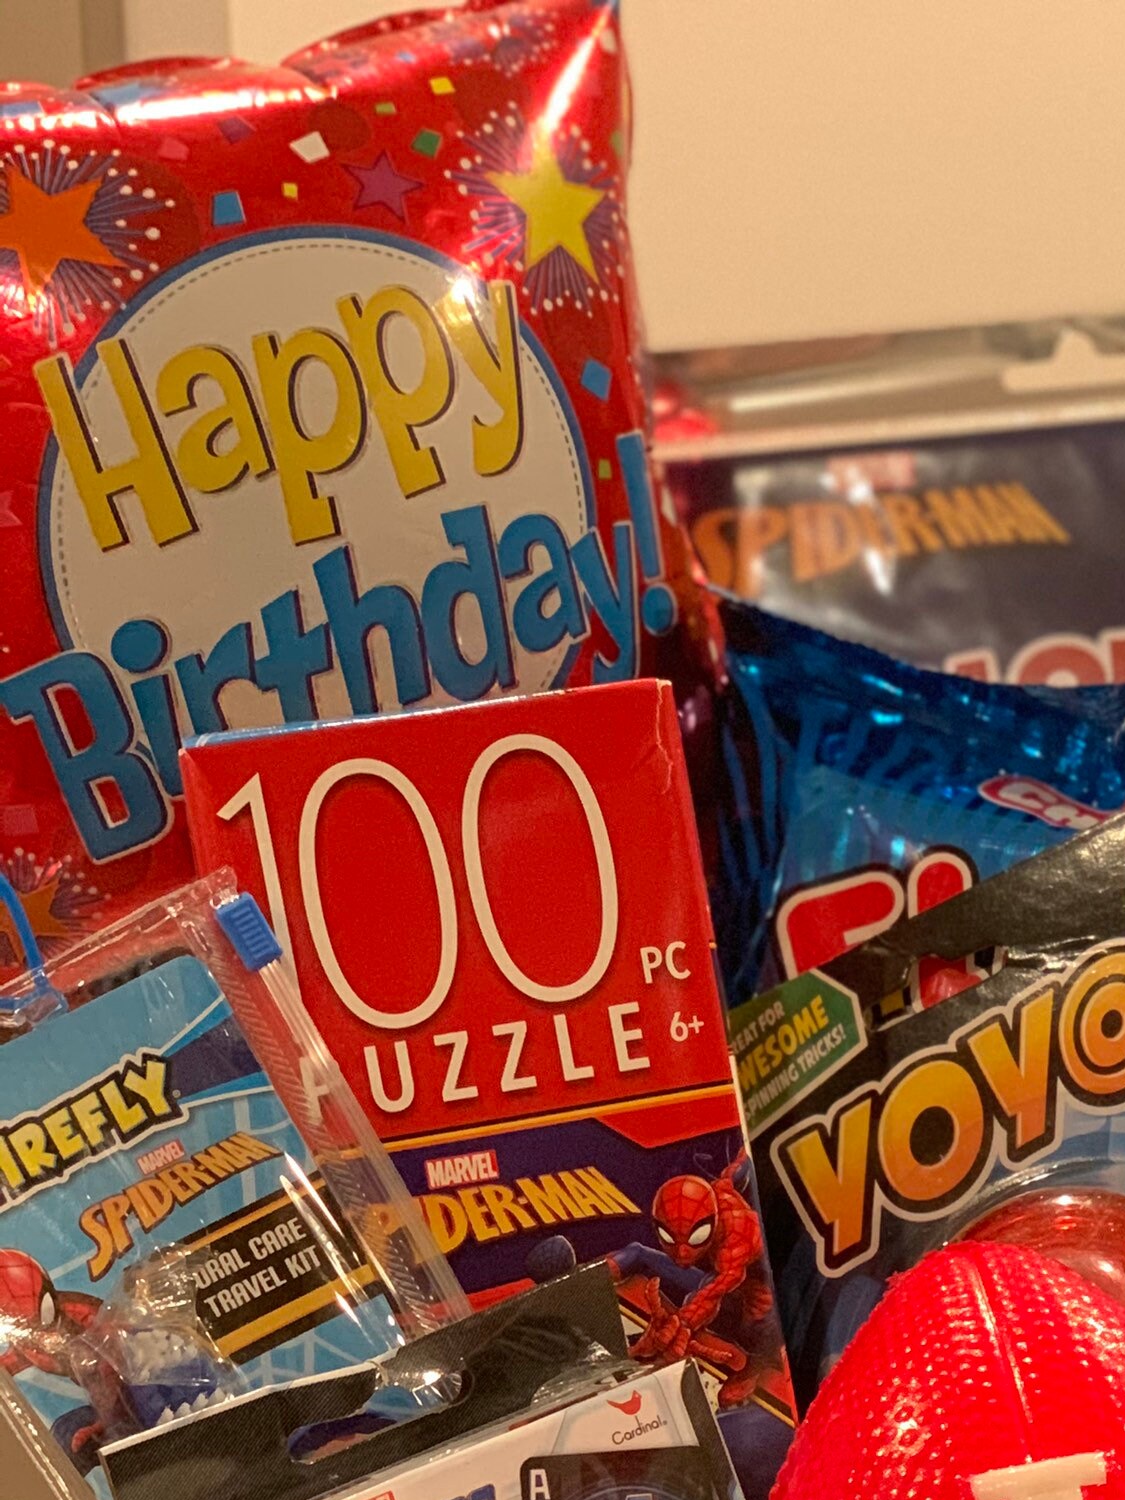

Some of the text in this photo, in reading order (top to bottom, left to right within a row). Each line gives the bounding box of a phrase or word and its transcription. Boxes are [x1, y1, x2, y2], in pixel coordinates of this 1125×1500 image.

[33, 282, 524, 552] Happy
[0, 433, 678, 866] Birthday!
[215, 733, 692, 1029] 100 PC
[669, 1011, 705, 1042] 6+
[738, 994, 830, 1091] WESOME
[757, 1001, 785, 1033] FOR
[796, 1023, 847, 1073] TRICKS!
[0, 1060, 171, 1189] IREFLY
[137, 1139, 185, 1175] MARVEL
[425, 1149, 498, 1189] MARVEL
[79, 1131, 286, 1282] SPIDER-MAN
[247, 1217, 308, 1261] CARE
[204, 1245, 323, 1318] TRAVEL KIT
[611, 1414, 667, 1446] Cardinal
